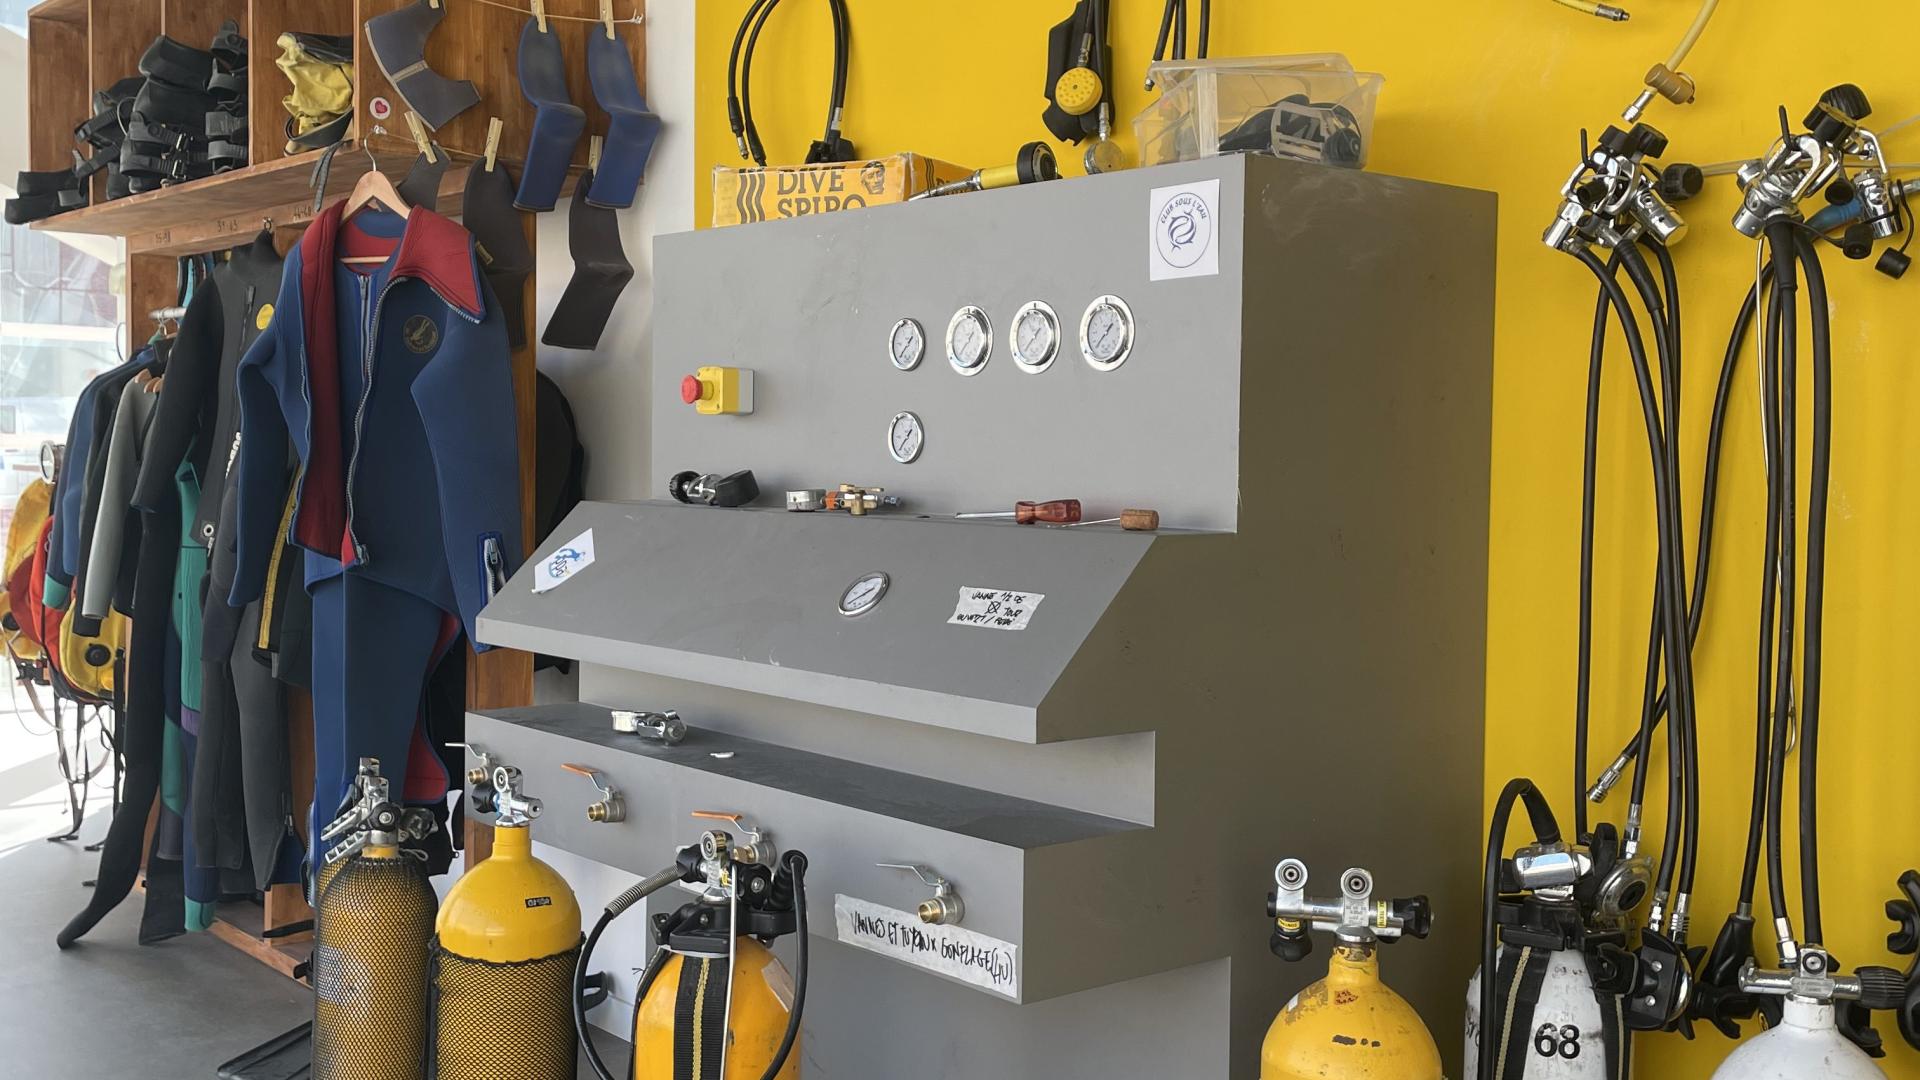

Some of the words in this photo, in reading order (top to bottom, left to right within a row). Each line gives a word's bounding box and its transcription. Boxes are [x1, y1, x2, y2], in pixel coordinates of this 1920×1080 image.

[777, 165, 846, 196] DIVE
[1160, 203, 1174, 224] CLUB
[1175, 197, 1192, 207] SOUS
[1192, 200, 1207, 219] L'EAU
[851, 911, 886, 938] VANNES
[888, 921, 899, 946] ET
[1534, 1022, 1581, 1060] 68
